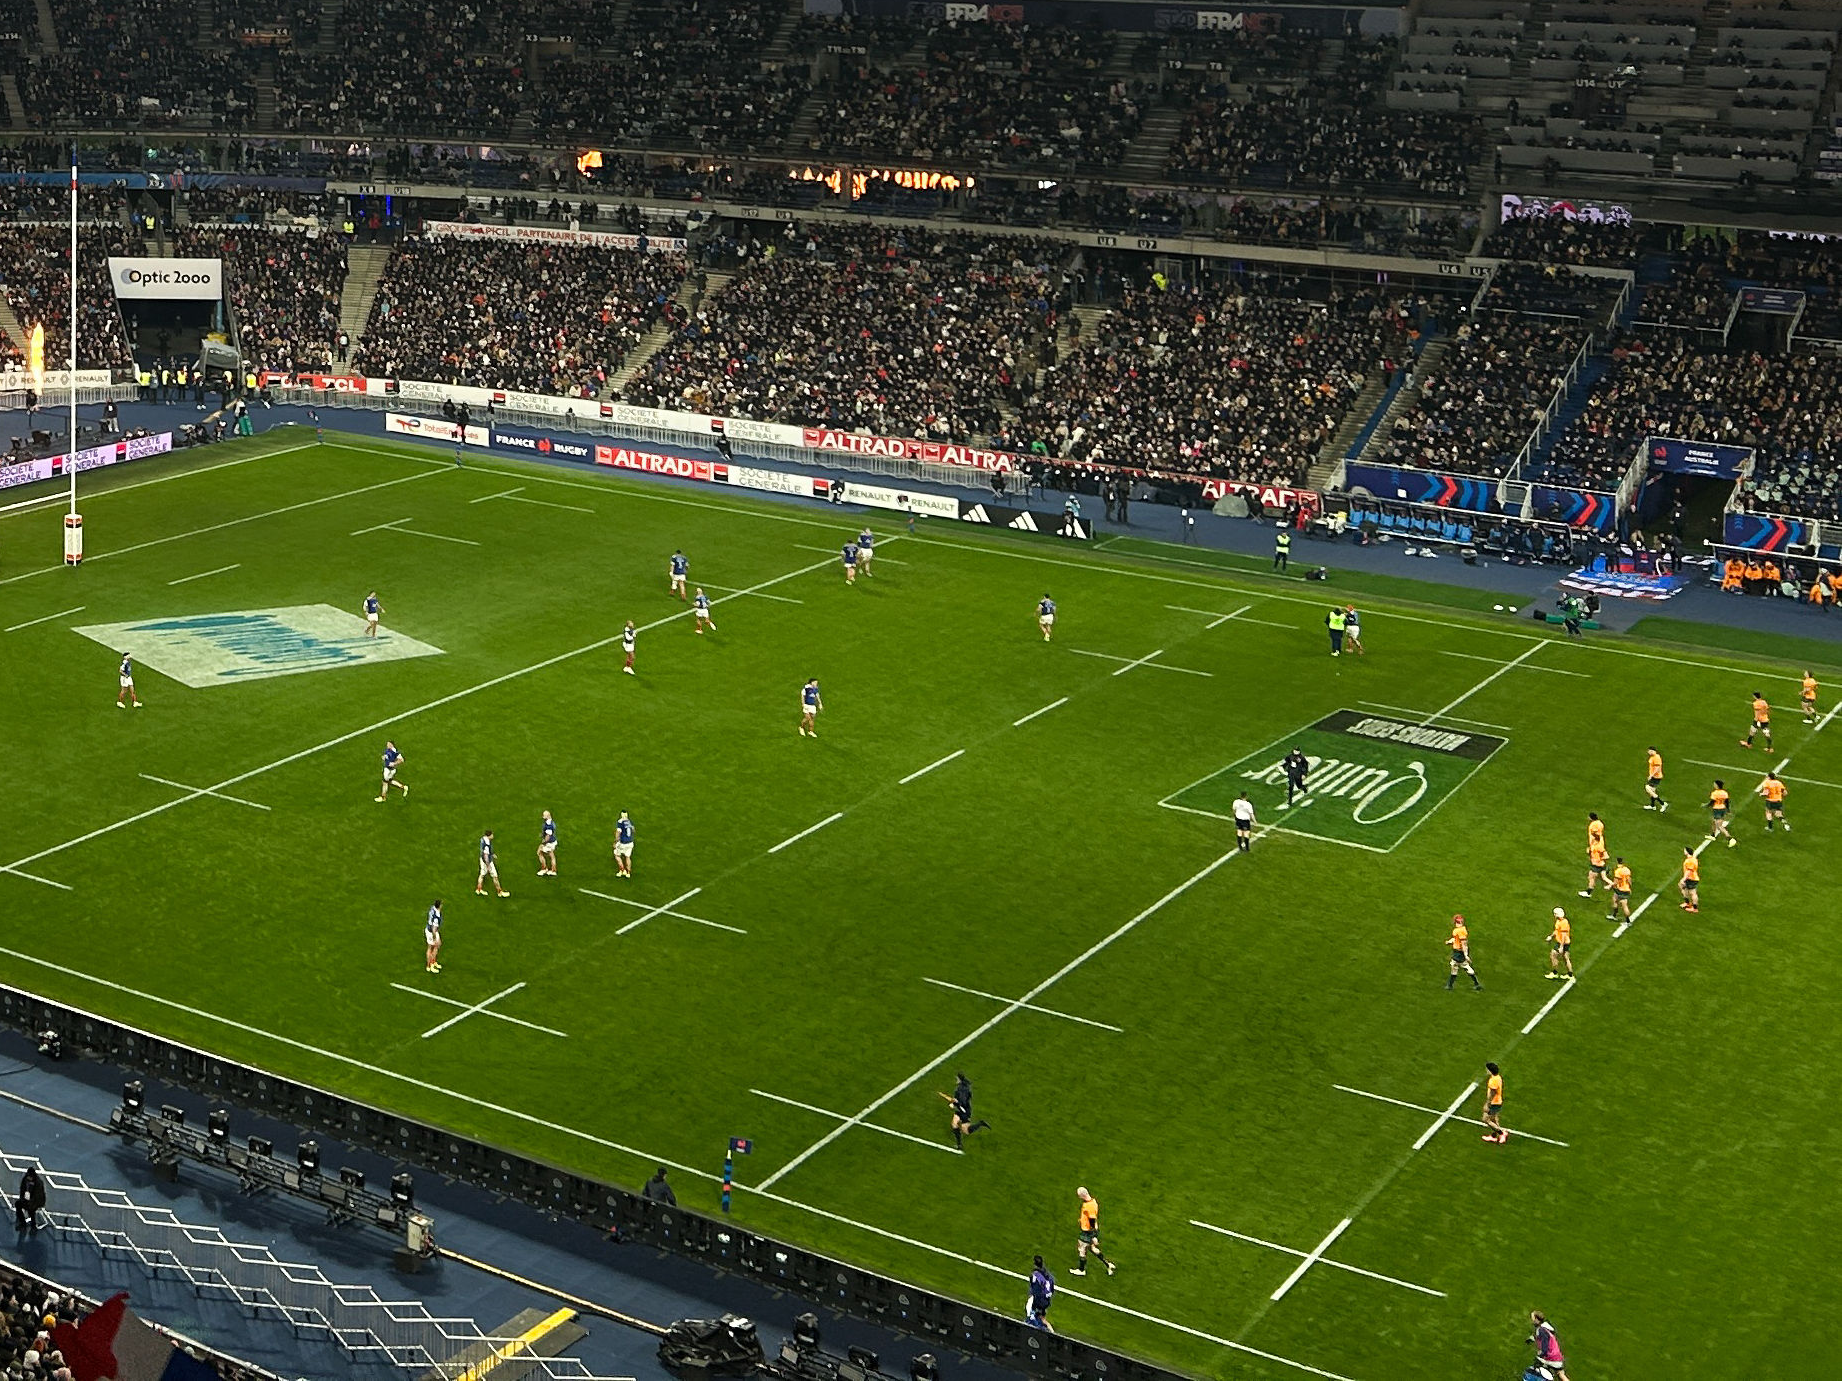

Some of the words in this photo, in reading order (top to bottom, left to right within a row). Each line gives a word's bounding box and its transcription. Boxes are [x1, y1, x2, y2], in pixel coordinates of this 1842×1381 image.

[129, 270, 171, 287] Optic
[173, 270, 210, 285] 2000
[128, 443, 168, 460] GENERALE
[129, 436, 160, 450] SOCIETE
[496, 435, 535, 449] FRANCE
[554, 444, 588, 456] RUGBY
[820, 433, 905, 457] ALTRAD
[614, 450, 693, 476] ALTRAD
[942, 447, 1012, 472] ALTRA
[0, 462, 34, 477] SOCIETE
[740, 468, 789, 483] SOCIETE
[738, 478, 802, 494] GENERALE
[848, 489, 892, 502] RENAULT
[911, 498, 954, 512] RENAULT
